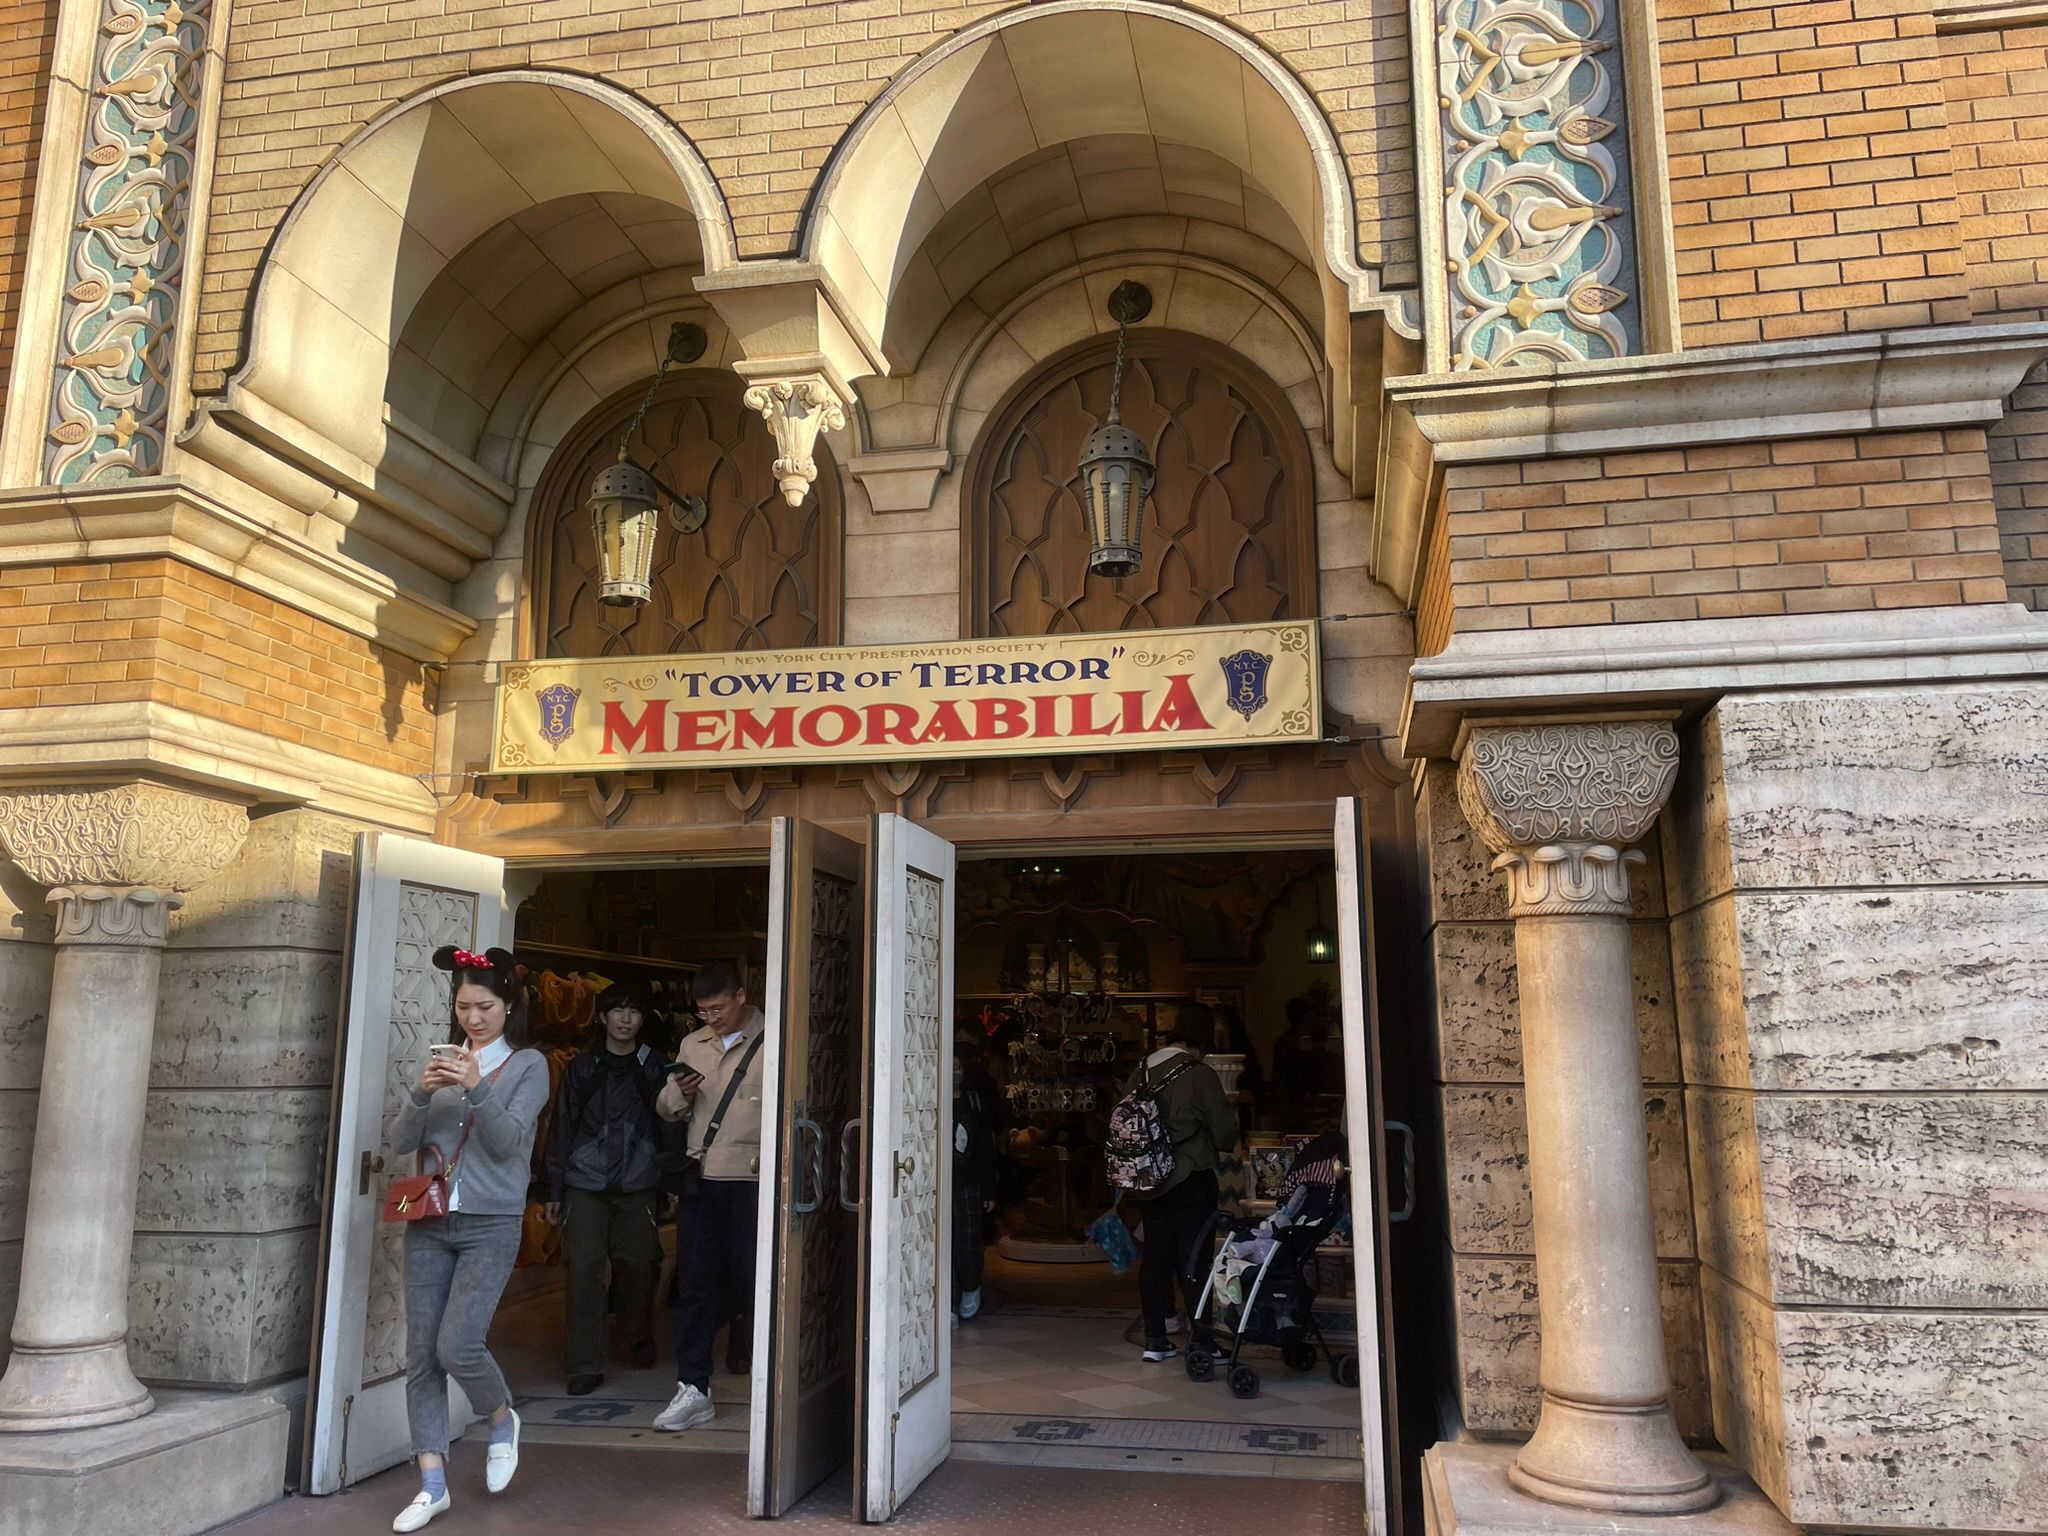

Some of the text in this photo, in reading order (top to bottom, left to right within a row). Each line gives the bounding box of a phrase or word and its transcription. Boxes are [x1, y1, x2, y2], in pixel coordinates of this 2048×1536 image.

[735, 642, 1047, 665] NEW YORK CITY PRESERVATION SOCIETY
[854, 670, 902, 688] OF
[598, 673, 1217, 756] MEMORABILIA
